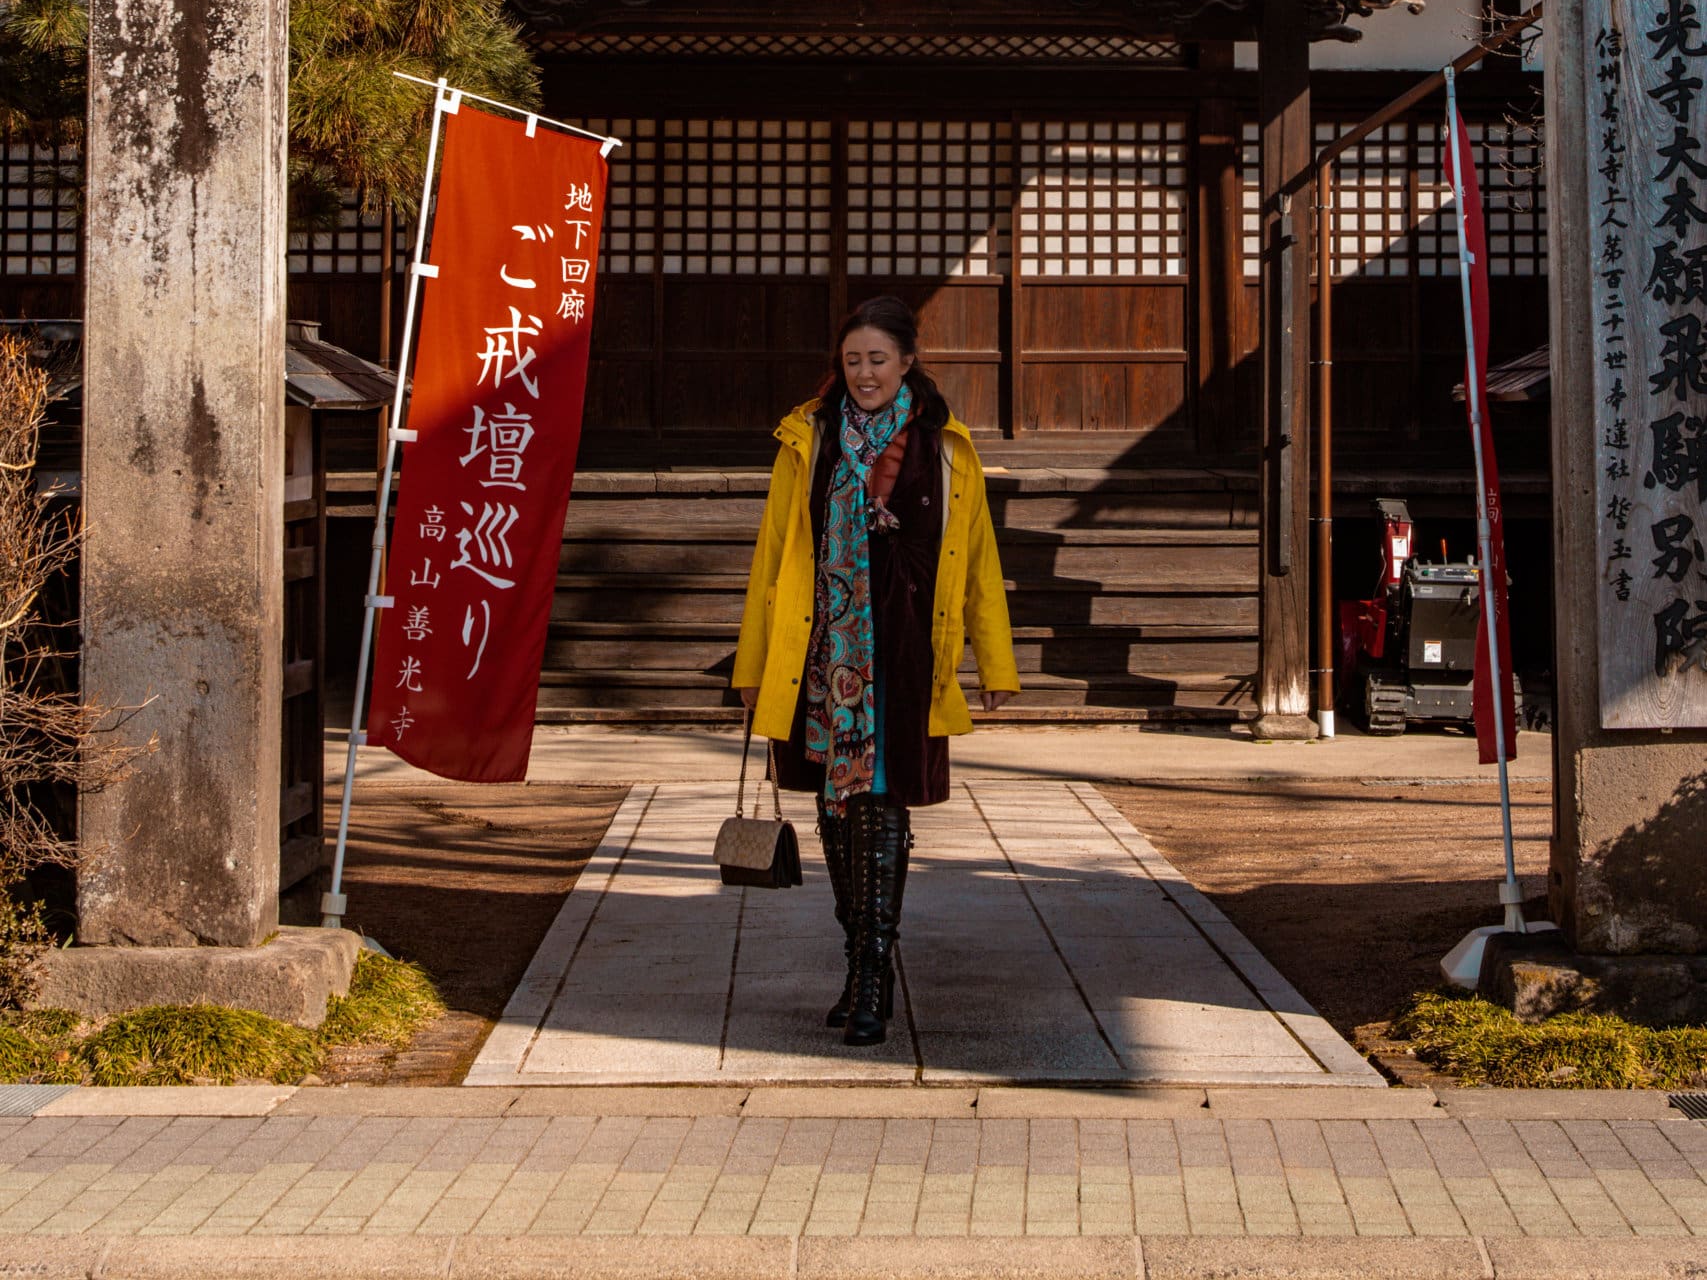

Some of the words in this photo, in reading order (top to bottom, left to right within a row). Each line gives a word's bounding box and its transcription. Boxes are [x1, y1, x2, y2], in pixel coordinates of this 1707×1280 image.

[555, 181, 593, 325] 地下回廊
[449, 222, 555, 681] ご戒壇巡り
[390, 504, 447, 742] 高山善光寺
